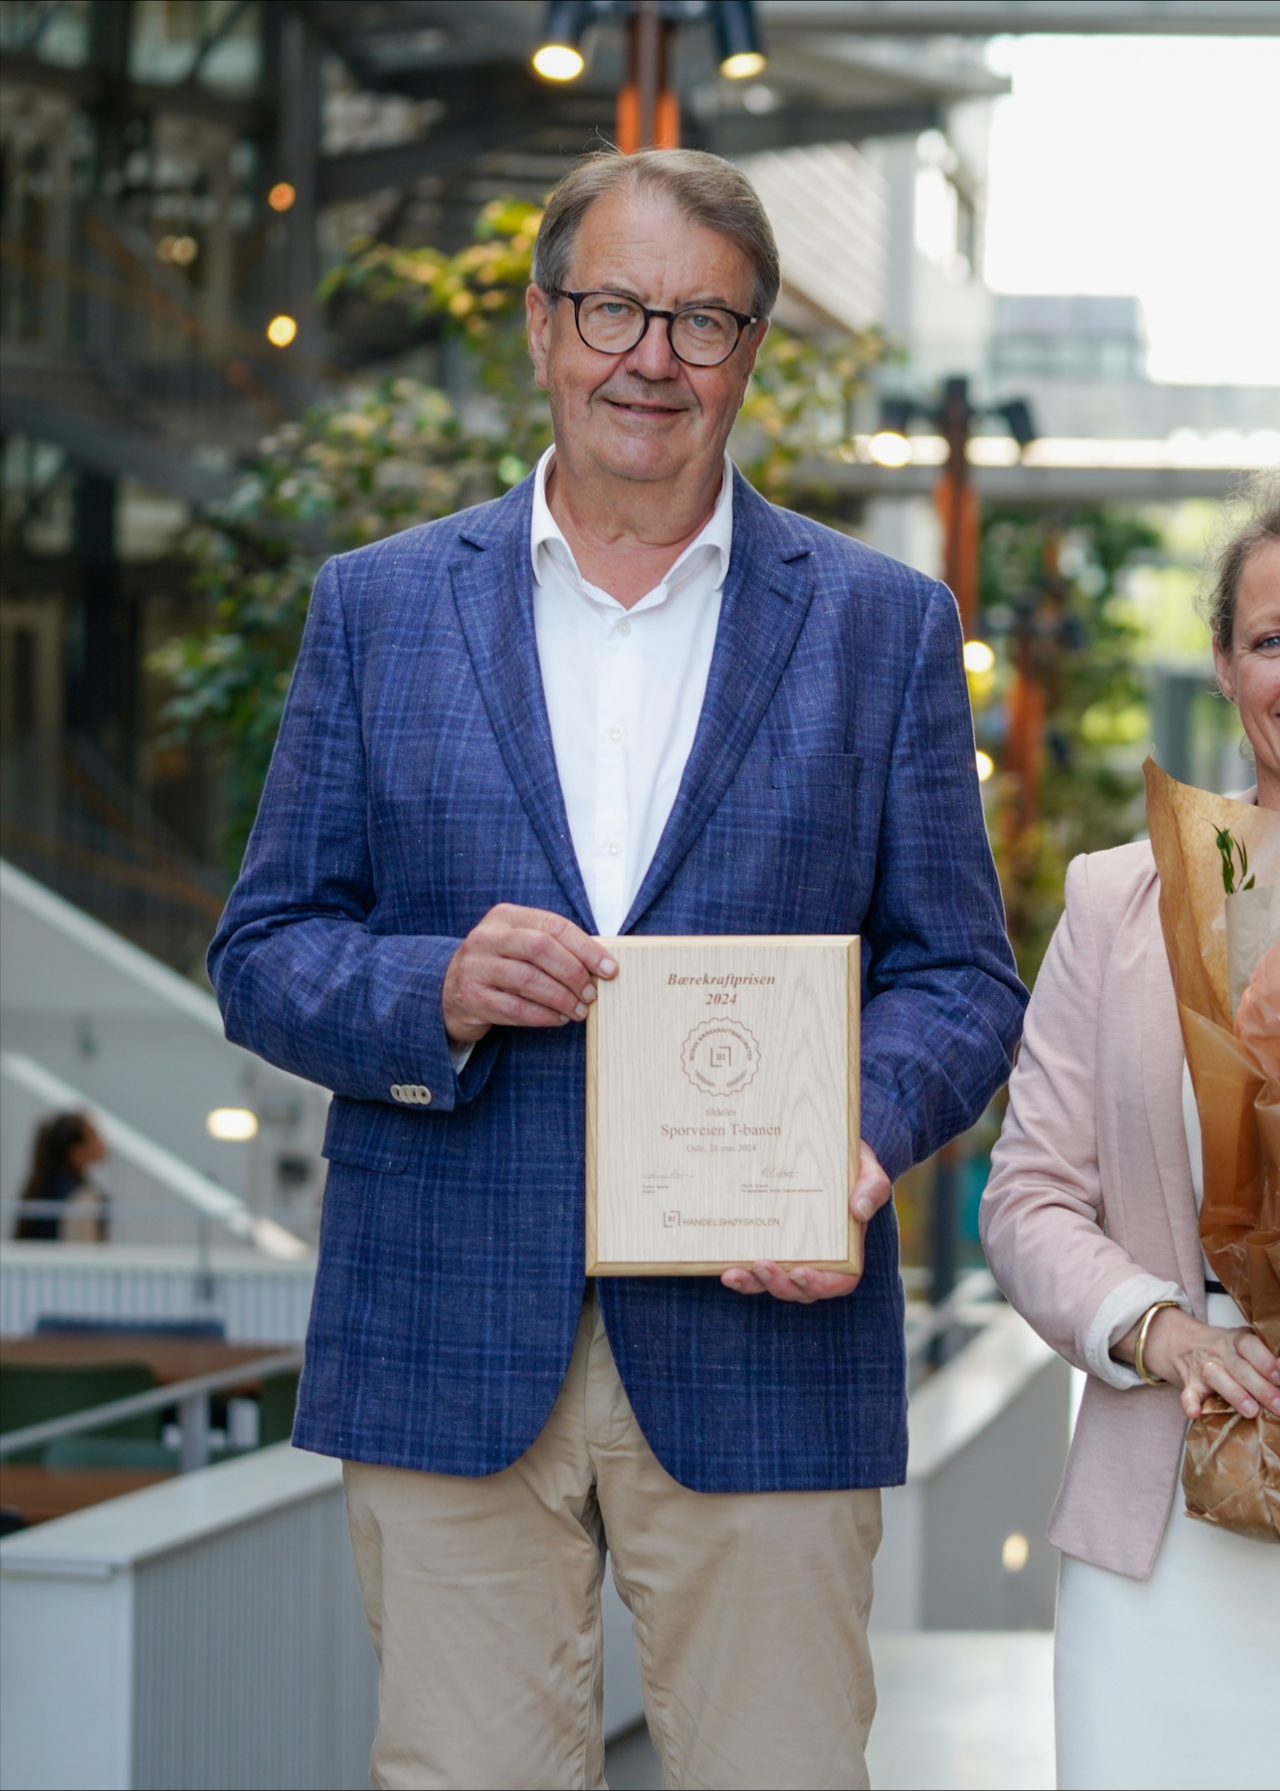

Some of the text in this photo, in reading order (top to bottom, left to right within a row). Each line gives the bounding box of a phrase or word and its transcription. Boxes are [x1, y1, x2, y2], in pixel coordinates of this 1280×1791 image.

[667, 973, 776, 988] Bærekraftprisen
[705, 993, 738, 1005] 2024
[660, 1123, 782, 1139] Sporveien T-banen
[682, 1217, 780, 1226] HANDELSHØYSKOLEN
